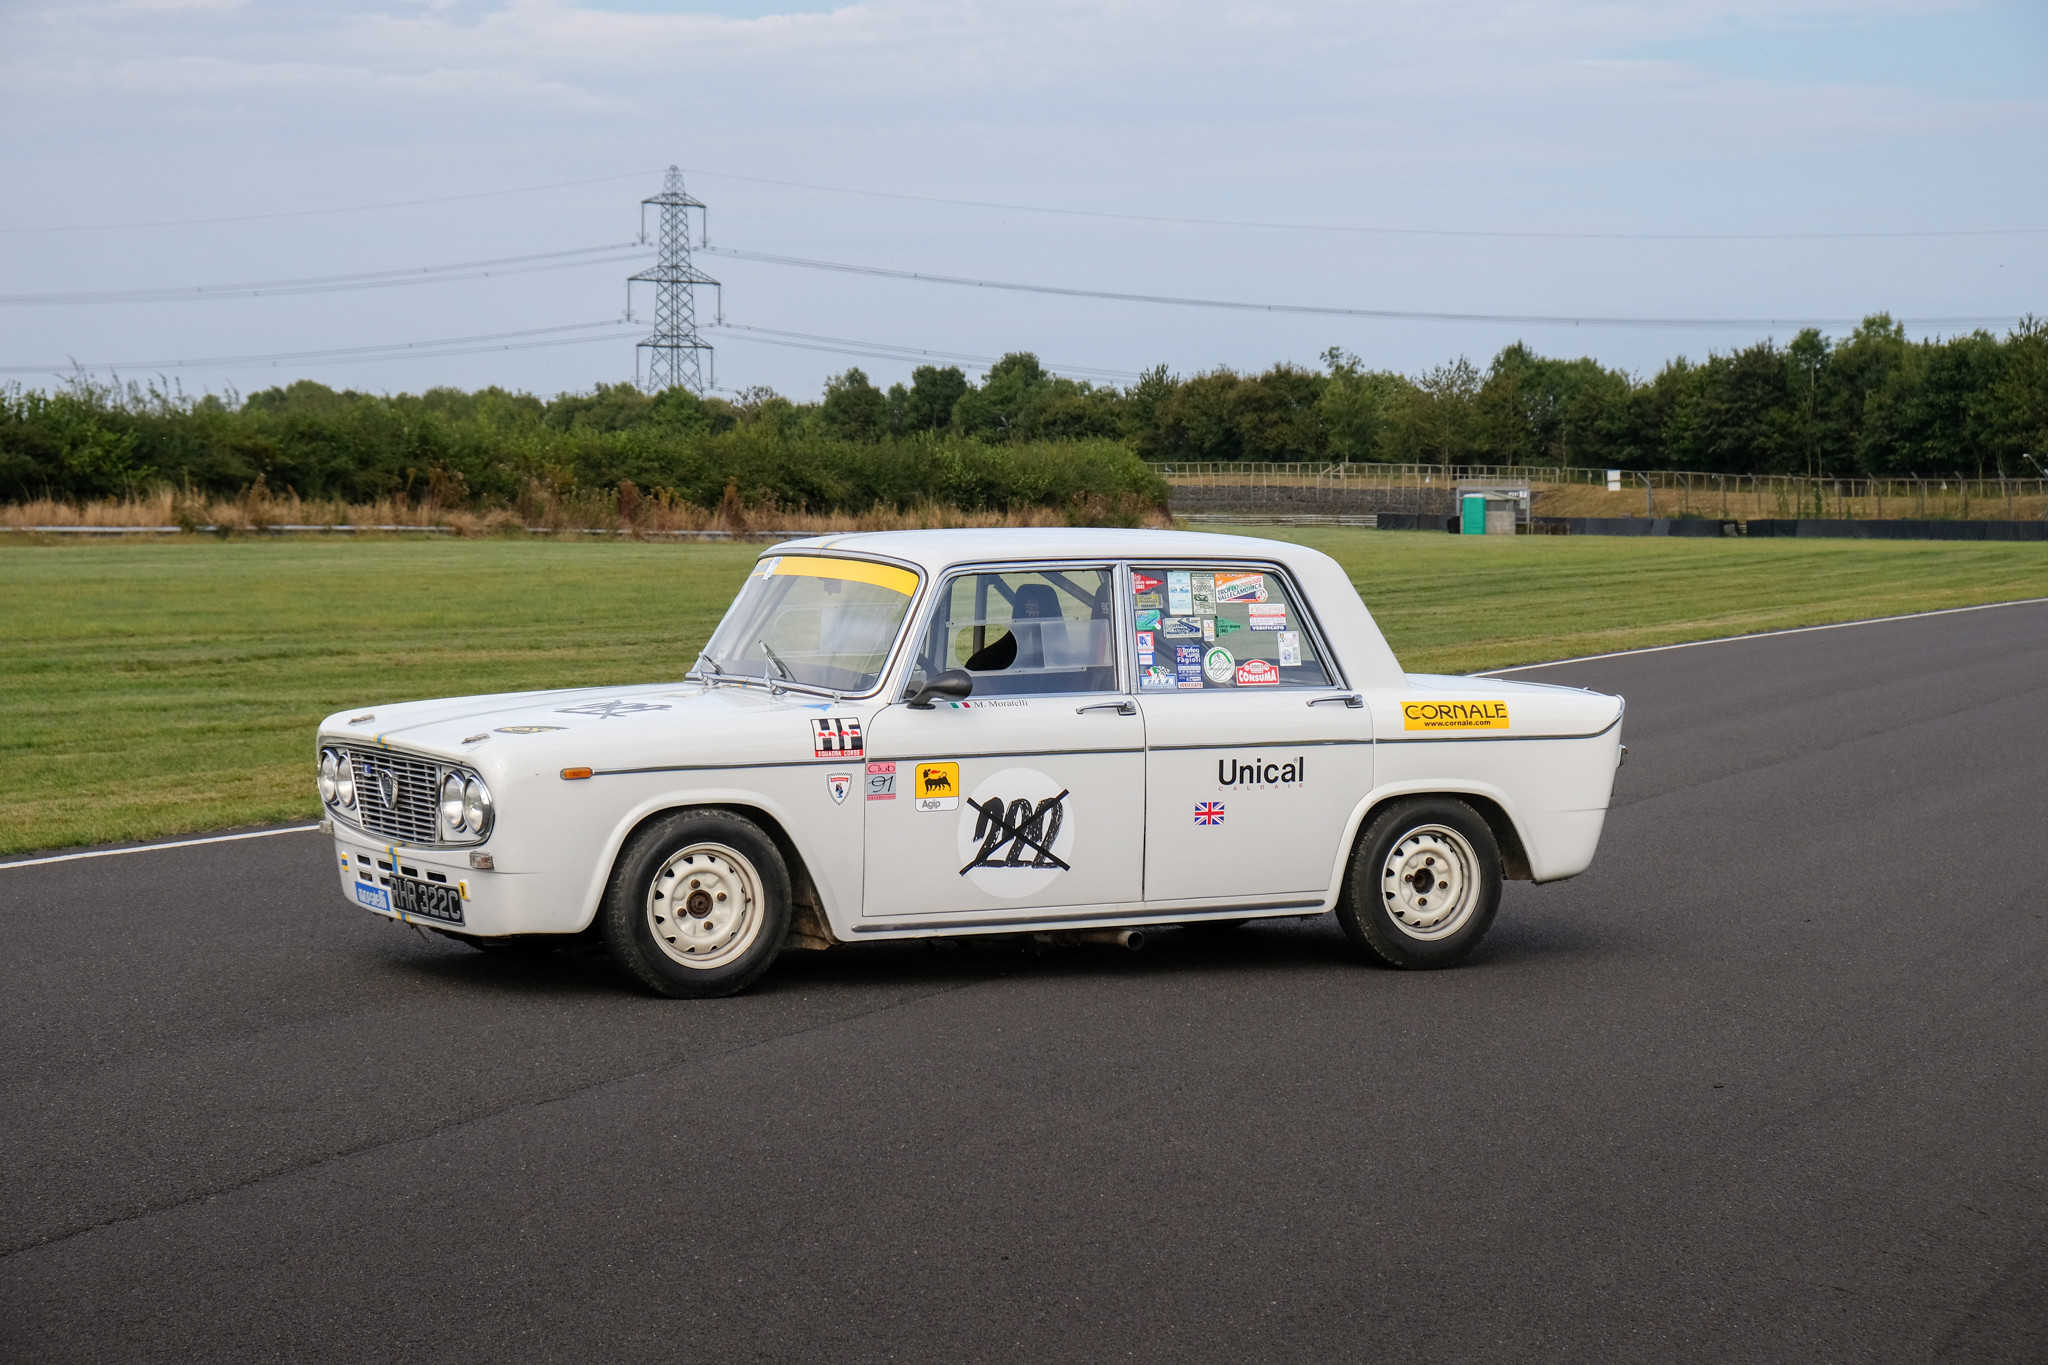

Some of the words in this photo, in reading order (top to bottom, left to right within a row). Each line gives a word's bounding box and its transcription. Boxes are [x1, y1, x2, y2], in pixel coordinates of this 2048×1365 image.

[1217, 584, 1239, 596] TROFEO
[1217, 583, 1262, 601] VALLECAMONICA
[1176, 656, 1201, 664] Fagioli
[1238, 669, 1277, 682] CONSUMA
[989, 699, 1029, 708] Moratelli
[1404, 703, 1508, 720] CORNALE
[1424, 719, 1491, 727] www.cornale.com
[817, 750, 842, 758] SQUADRA
[843, 749, 861, 757] CORSE
[867, 763, 897, 774] Club
[1218, 756, 1304, 786] Unical
[868, 775, 894, 793] 91
[1218, 782, 1304, 792] CALDAIE
[921, 799, 941, 810] Agip
[389, 876, 419, 912] RHR
[418, 884, 461, 920] 322C
